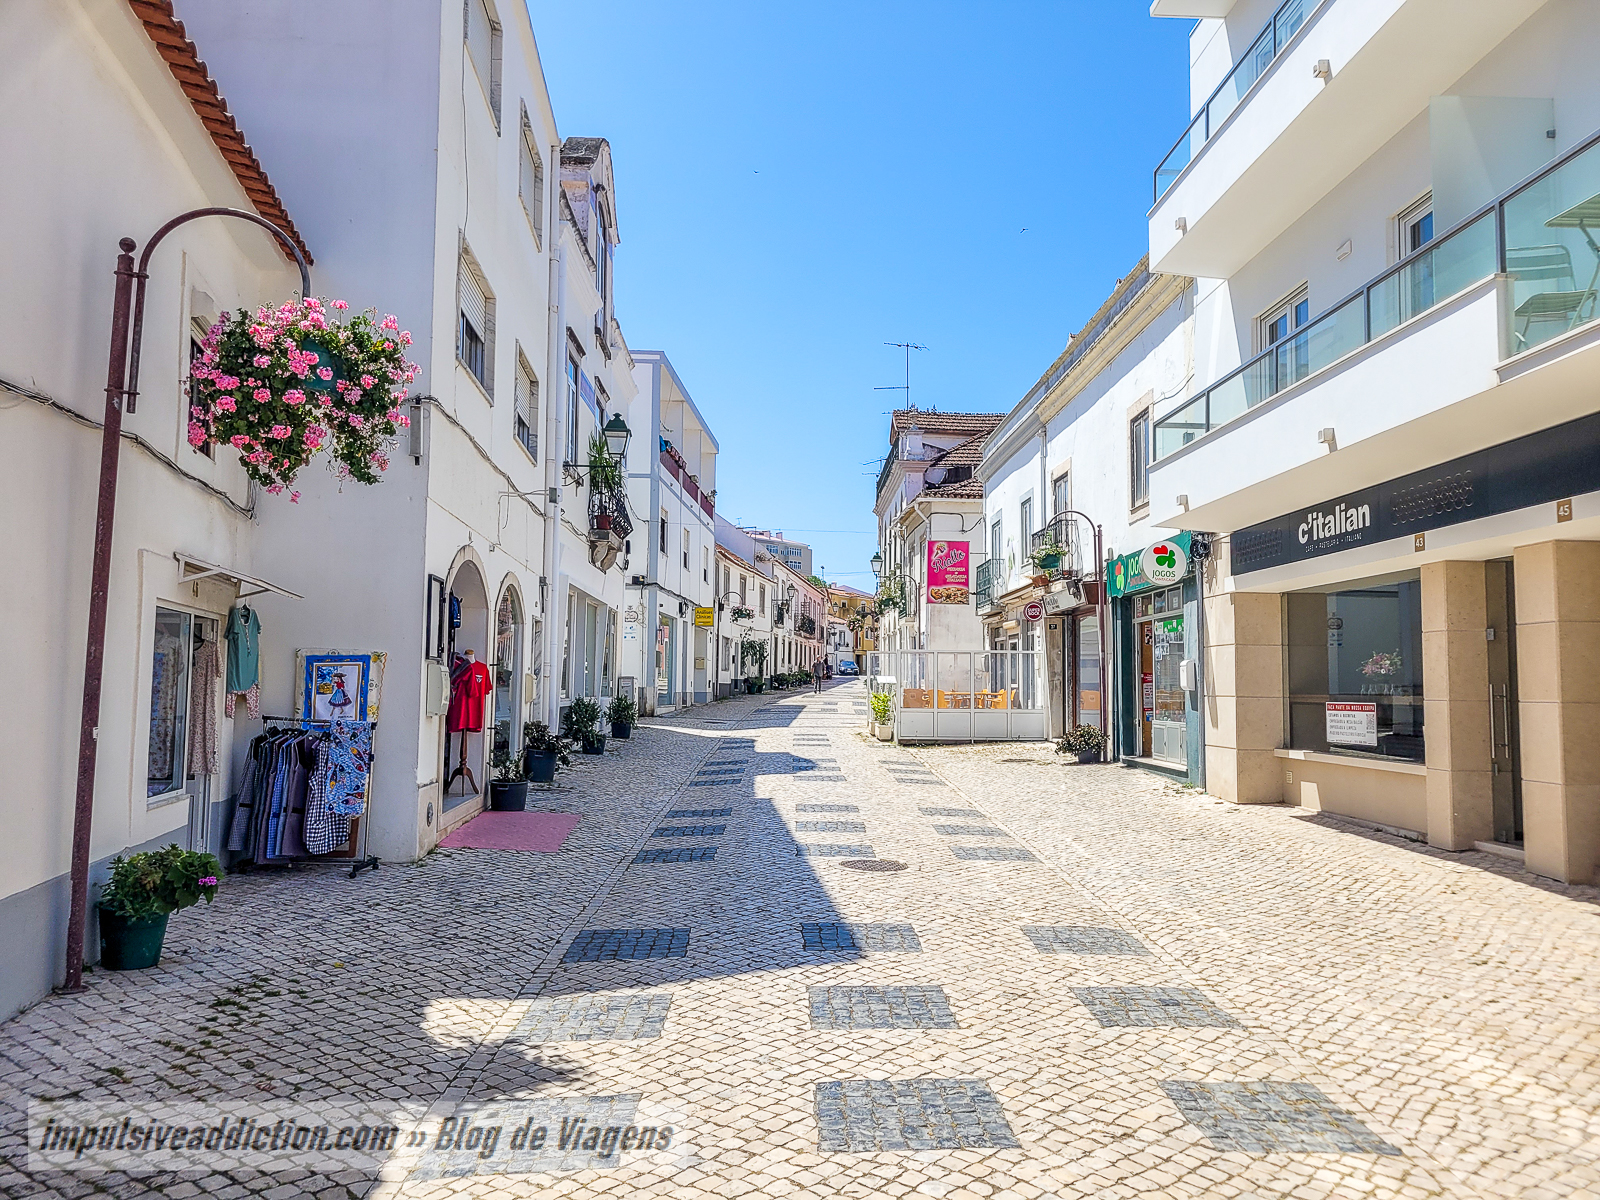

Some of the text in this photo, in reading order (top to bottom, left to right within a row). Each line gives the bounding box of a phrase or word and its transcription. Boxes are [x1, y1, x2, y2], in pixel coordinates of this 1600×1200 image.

[1558, 504, 1570, 516] 45
[1298, 503, 1371, 544] c'italian
[1344, 532, 1362, 542] ITALIANO
[1415, 537, 1424, 548] 43
[931, 549, 965, 573] Rialto
[1152, 570, 1176, 579] JOGOS
